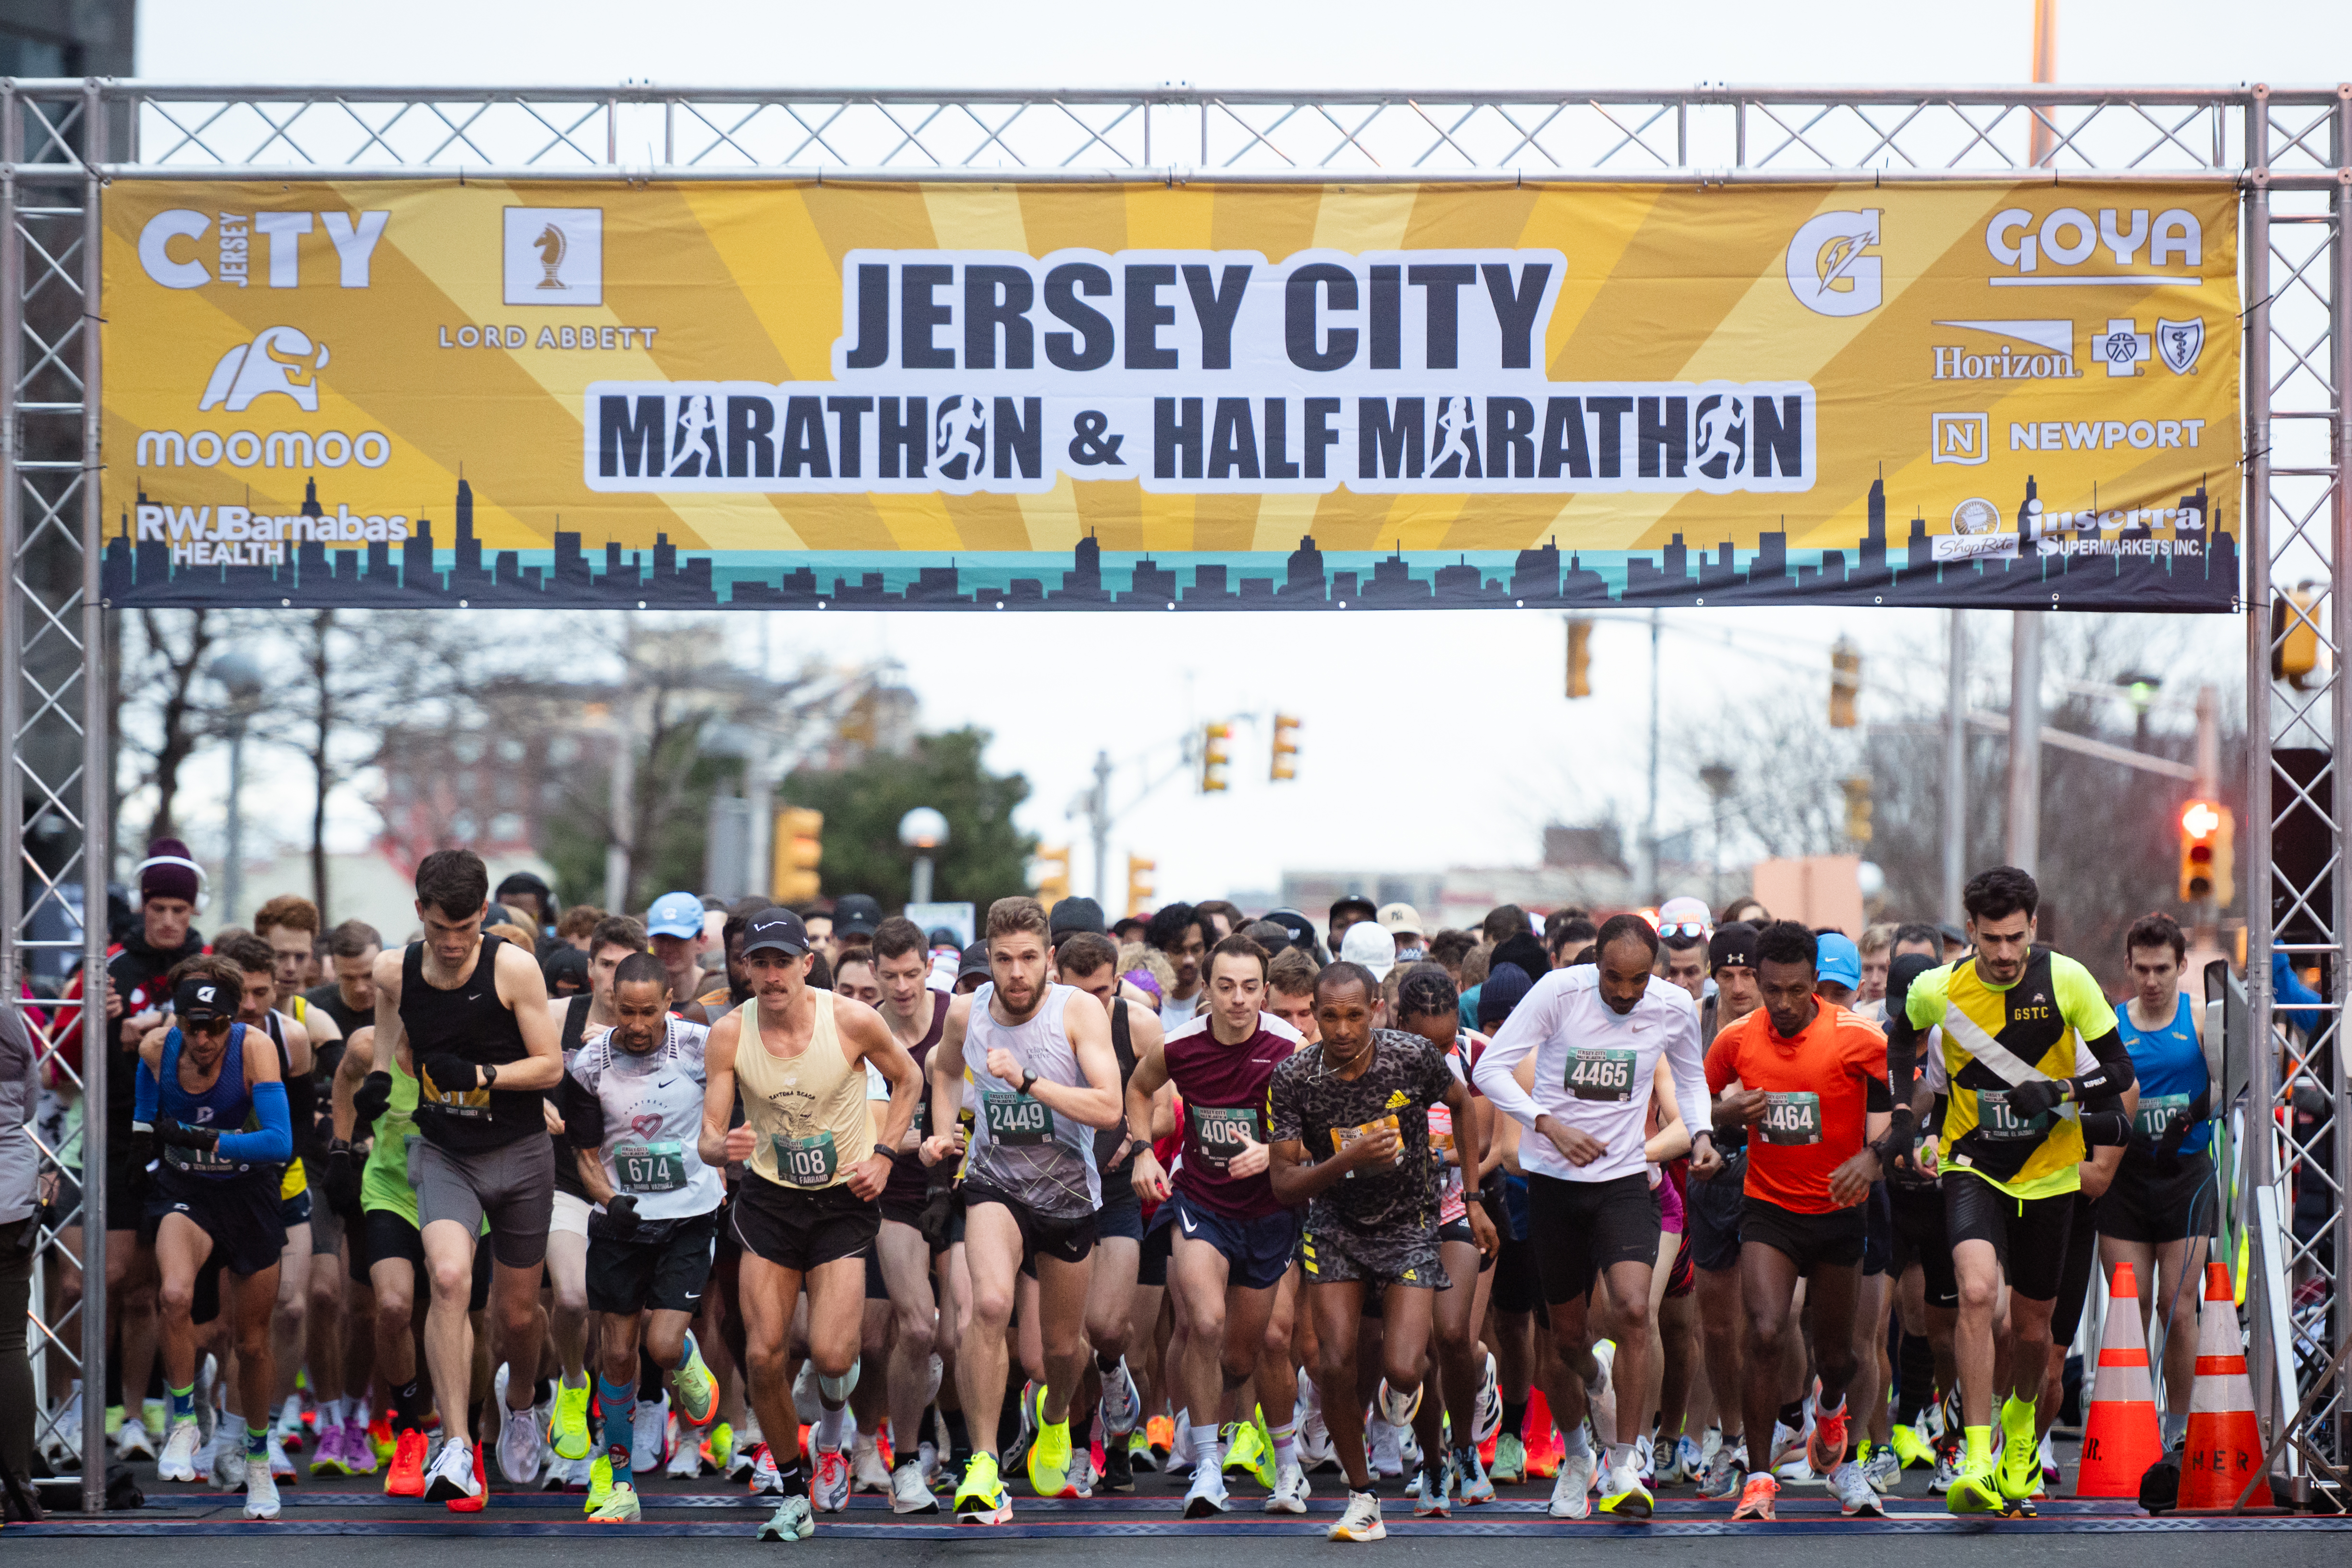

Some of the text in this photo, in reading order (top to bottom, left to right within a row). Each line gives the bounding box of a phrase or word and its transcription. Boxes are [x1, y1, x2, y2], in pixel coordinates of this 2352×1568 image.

[219, 211, 249, 288] JERSEY
[1985, 208, 2202, 273] GOYA
[846, 262, 1552, 372] JERSEY CITY
[439, 326, 658, 350] LORD ABBETT
[1932, 346, 2075, 379] Horizon
[599, 394, 1802, 479] MARATHON & HALF MARATHON
[2010, 419, 2205, 450] NEWPORT
[137, 430, 391, 468] moomoo
[137, 504, 408, 542] RWJBarnabas
[2027, 498, 2205, 542] inserra
[172, 540, 285, 566] HEALTH
[1937, 537, 2013, 558] ShopRite
[2036, 536, 2203, 557] SUPERMARKETS INC.
[2015, 1006, 2049, 1020] GSTC
[1571, 1062, 1628, 1087] 4465
[2083, 1076, 2107, 1088] KIPRUN
[797, 1091, 815, 1100] BEACH
[1385, 1099, 1411, 1109] adidas
[990, 1103, 1045, 1130] 2449
[1761, 1105, 1814, 1130] 4464
[1992, 1105, 2029, 1129] 10
[1201, 1120, 1252, 1144] 4008
[628, 1157, 671, 1182] 674
[787, 1150, 826, 1175] 108
[799, 1174, 828, 1184] FARRAND
